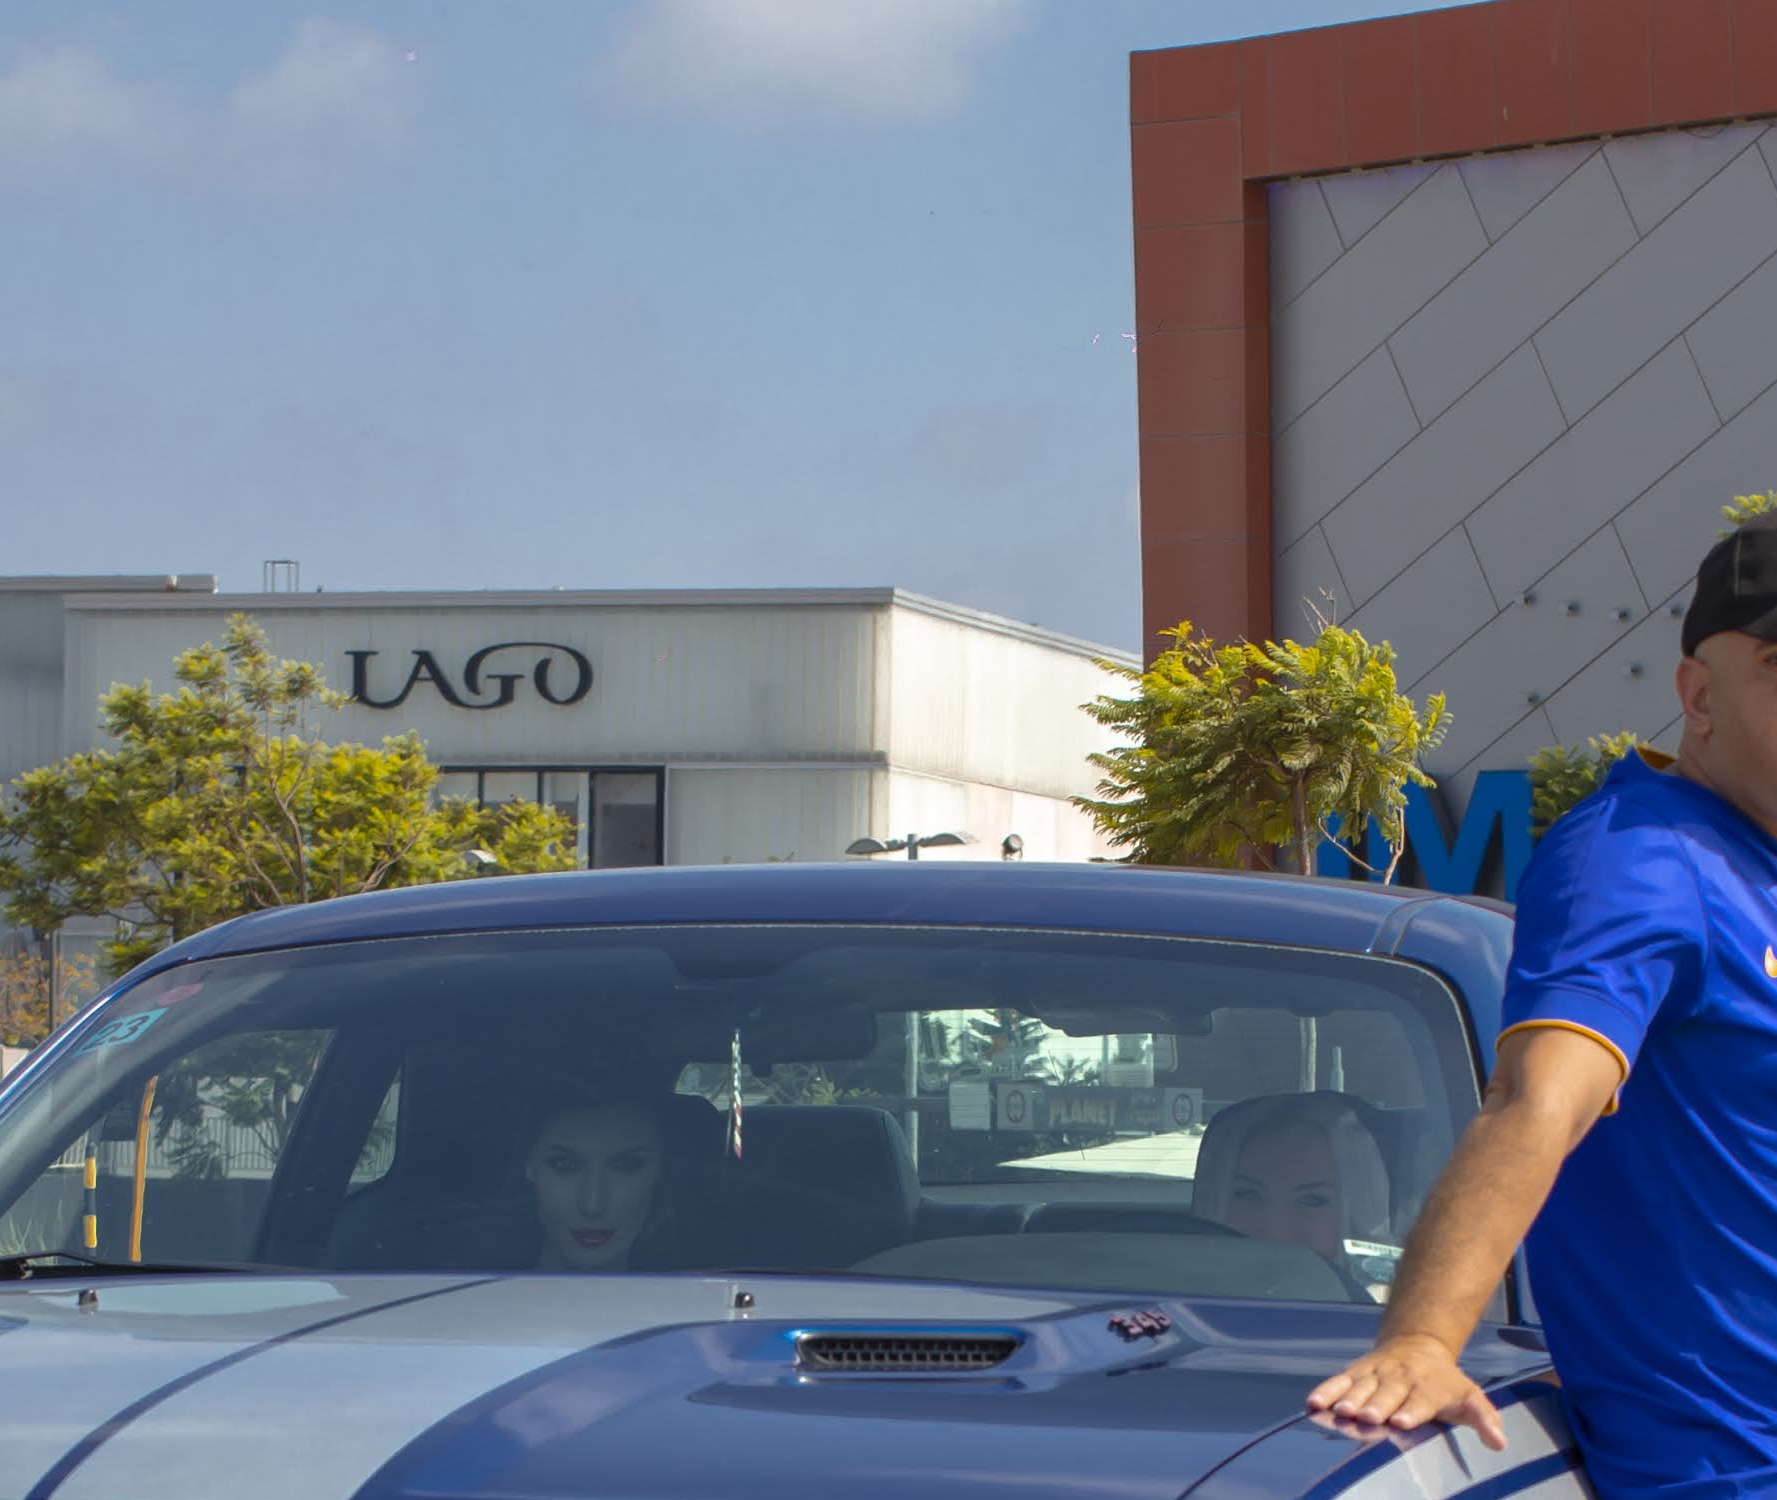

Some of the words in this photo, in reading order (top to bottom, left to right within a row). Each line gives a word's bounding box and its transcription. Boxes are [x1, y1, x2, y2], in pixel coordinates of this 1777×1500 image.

[344, 640, 594, 710] LAGO
[81, 1014, 151, 1051] 23
[1049, 1098, 1118, 1127] PLANET
